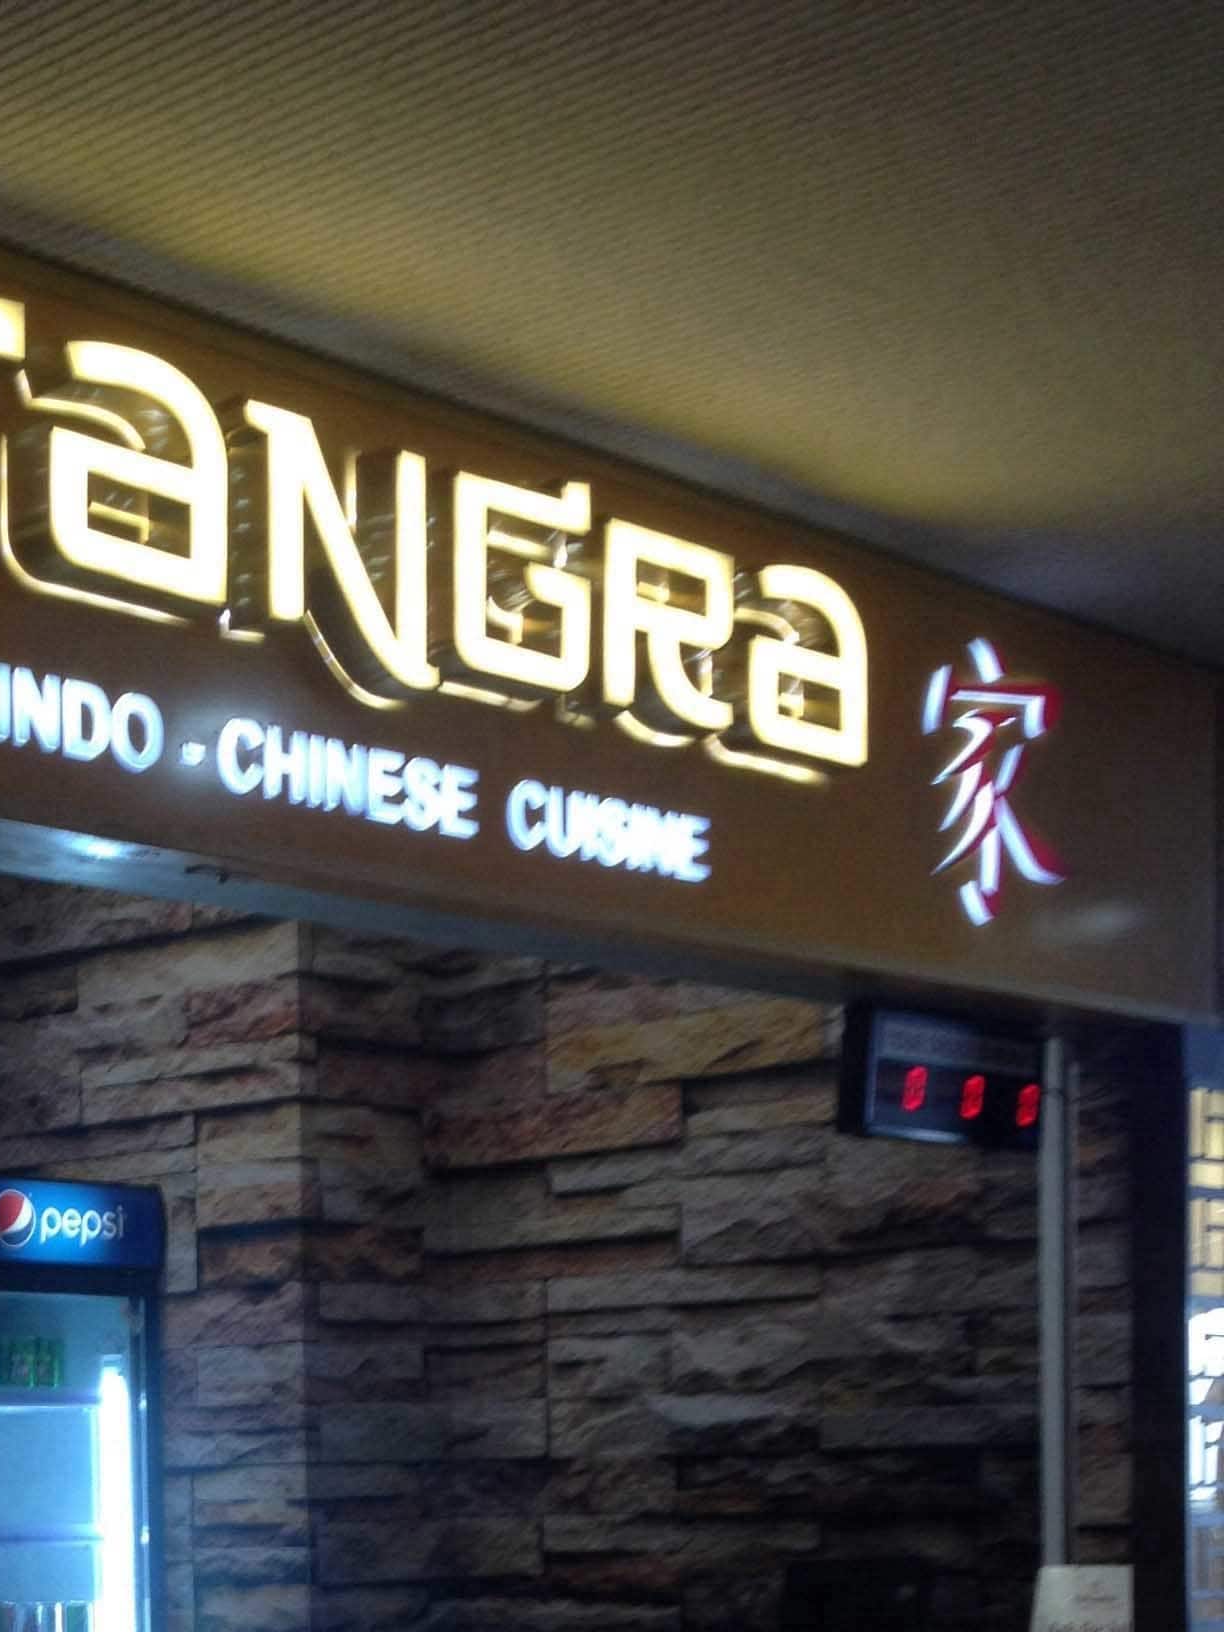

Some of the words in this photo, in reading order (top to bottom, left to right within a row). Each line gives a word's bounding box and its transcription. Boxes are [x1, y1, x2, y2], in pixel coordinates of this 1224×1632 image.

[218, 717, 480, 839] CHINESE
[506, 779, 712, 884] CUISINE
[921, 637, 1067, 928] 家
[40, 1204, 124, 1248] pepsi
